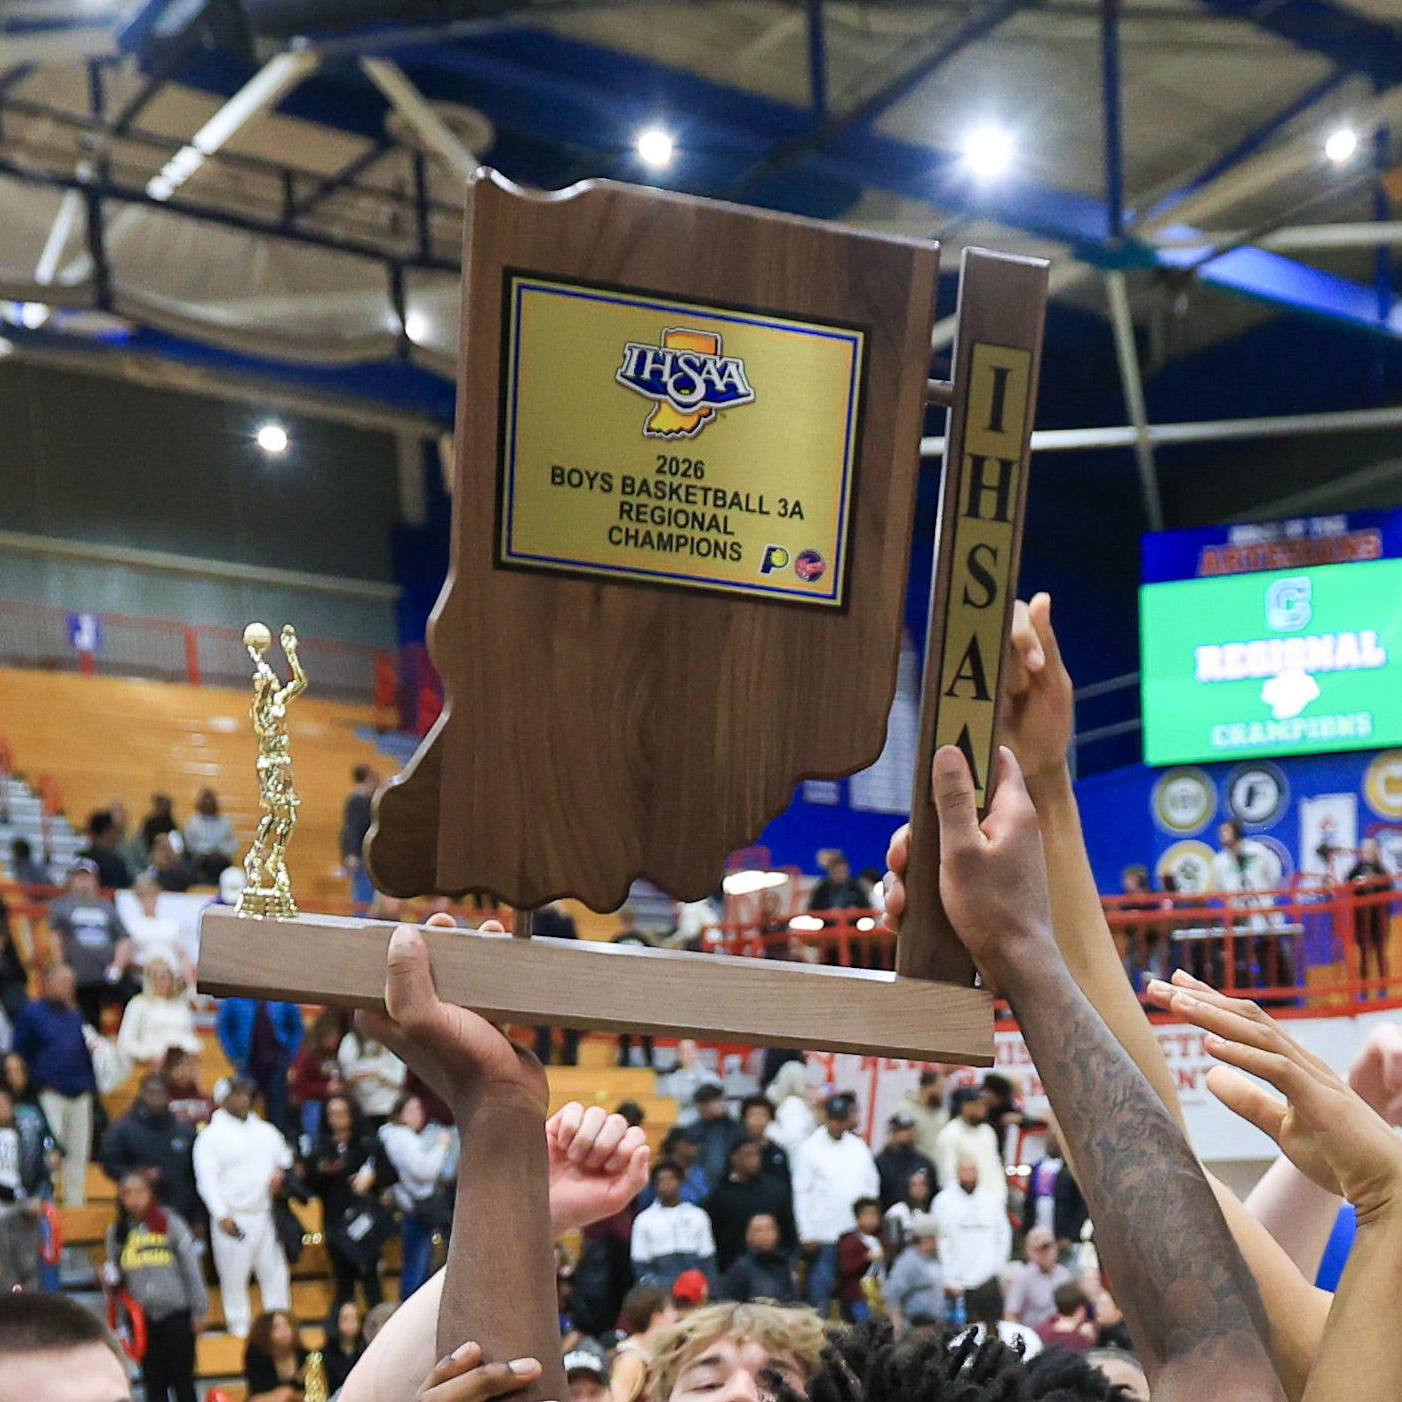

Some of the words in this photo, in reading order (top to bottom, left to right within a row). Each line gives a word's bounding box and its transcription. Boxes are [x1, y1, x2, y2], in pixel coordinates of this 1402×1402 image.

[619, 344, 753, 404] IHSAA
[656, 454, 706, 480] 2026
[550, 465, 614, 493] BOYS
[621, 480, 771, 516] BASKETBALL
[777, 498, 805, 521] 3A
[618, 501, 735, 536] REGIONAL
[608, 525, 743, 562] CHAMPIONS
[1264, 575, 1312, 632] C
[1195, 630, 1386, 682] REGIONAL
[1211, 711, 1373, 750] CHAMPIONS
